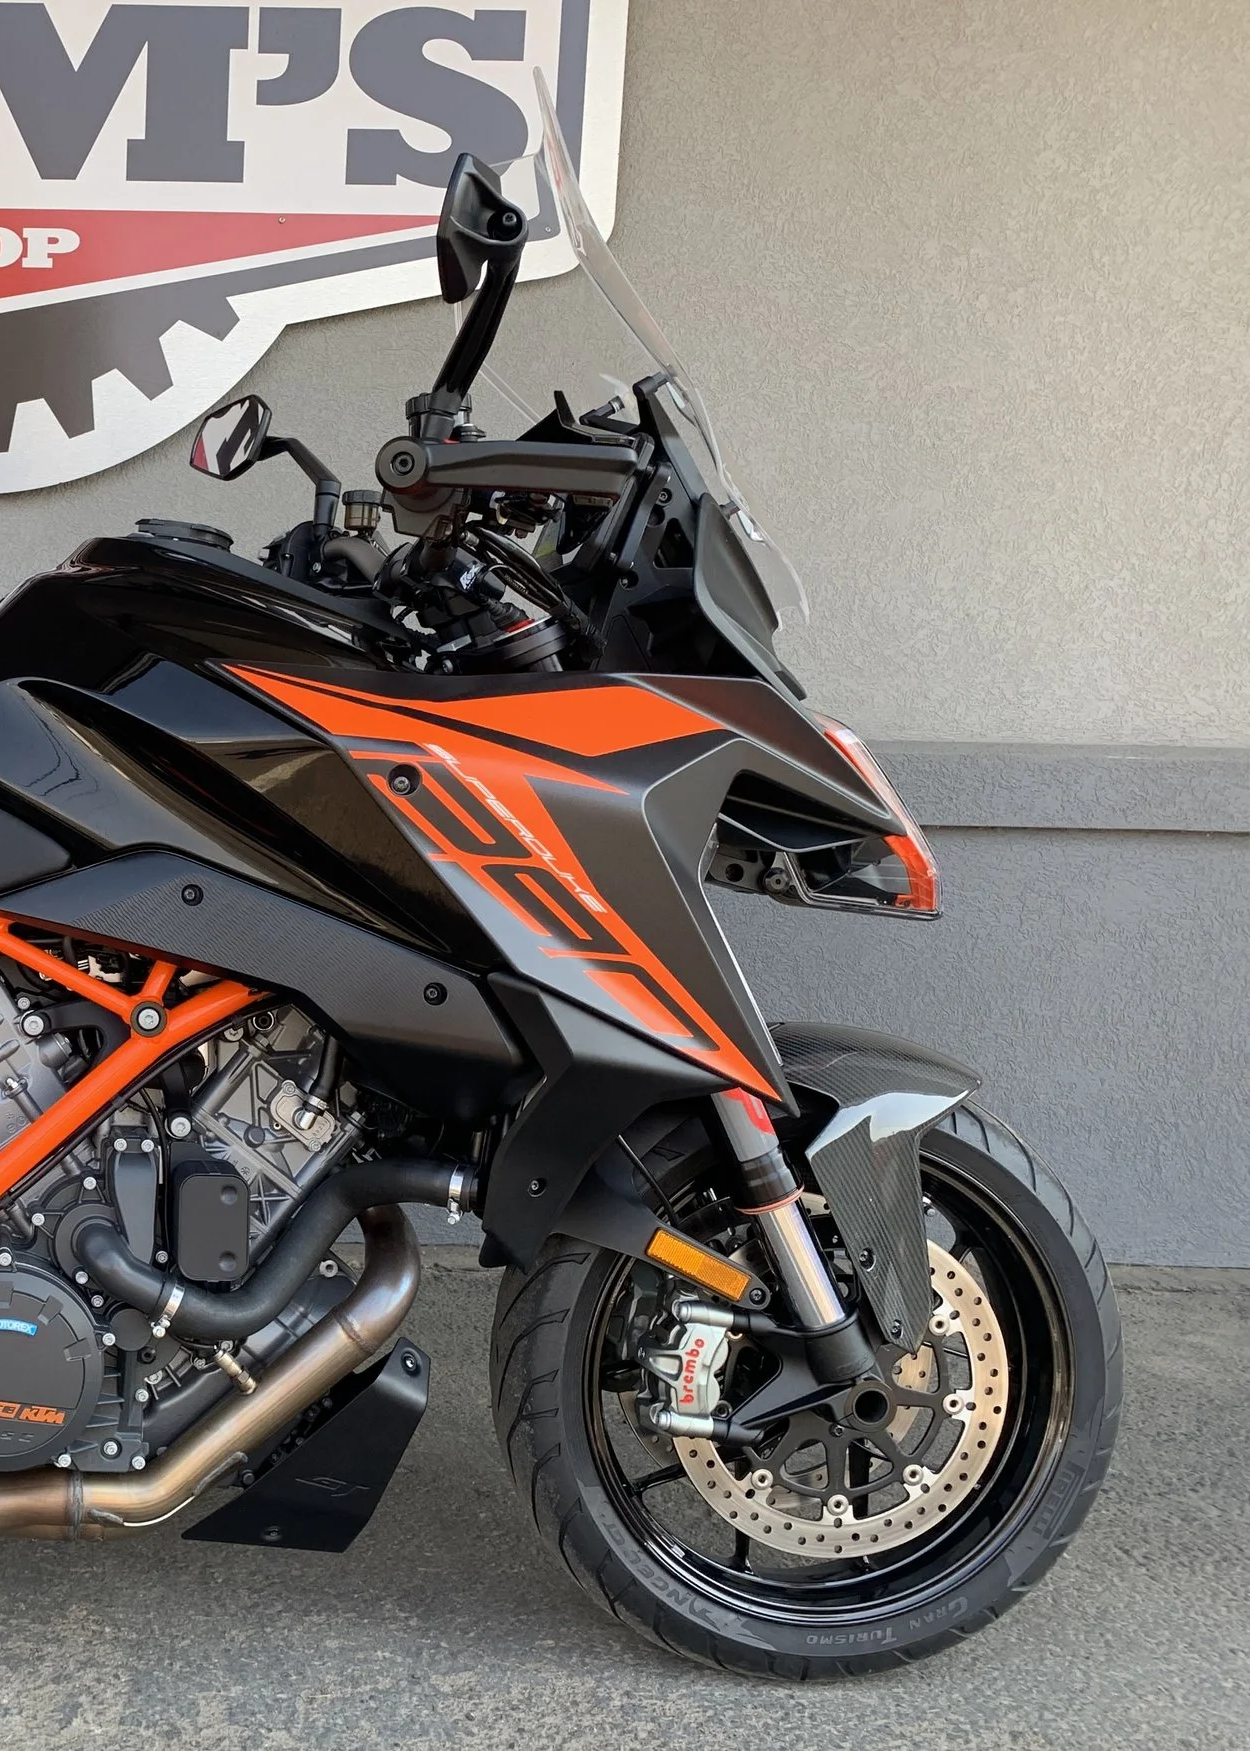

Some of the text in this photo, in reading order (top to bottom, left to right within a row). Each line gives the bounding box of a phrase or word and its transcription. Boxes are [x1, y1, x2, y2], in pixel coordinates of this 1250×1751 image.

[422, 743, 608, 914] SUPERDUKE
[679, 1338, 705, 1404] brembo
[18, 1405, 66, 1424] KTM
[805, 1596, 969, 1645] GRAN TURISMO
